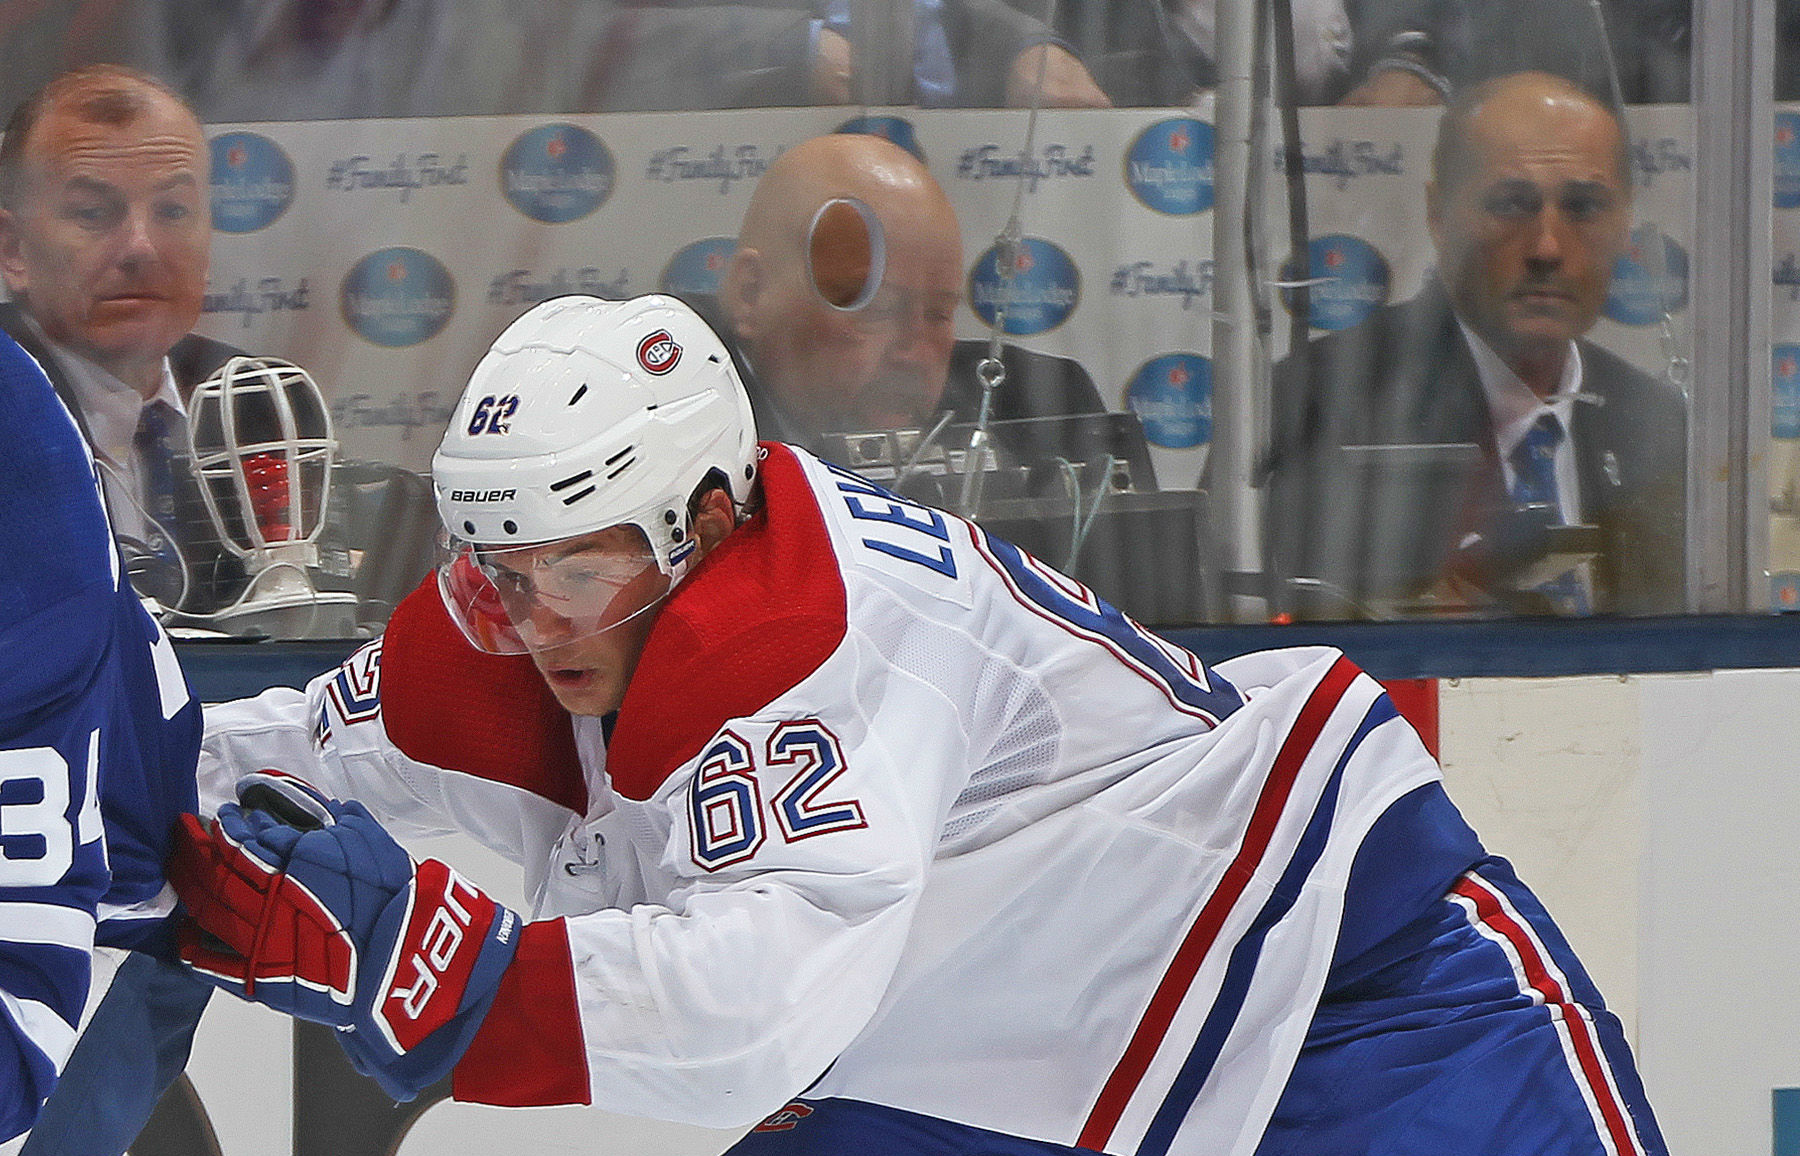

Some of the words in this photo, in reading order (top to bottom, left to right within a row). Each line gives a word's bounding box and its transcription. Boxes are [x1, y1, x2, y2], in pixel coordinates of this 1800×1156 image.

[468, 394, 521, 437] 62
[450, 487, 517, 503] BAUER
[687, 718, 869, 873] 62
